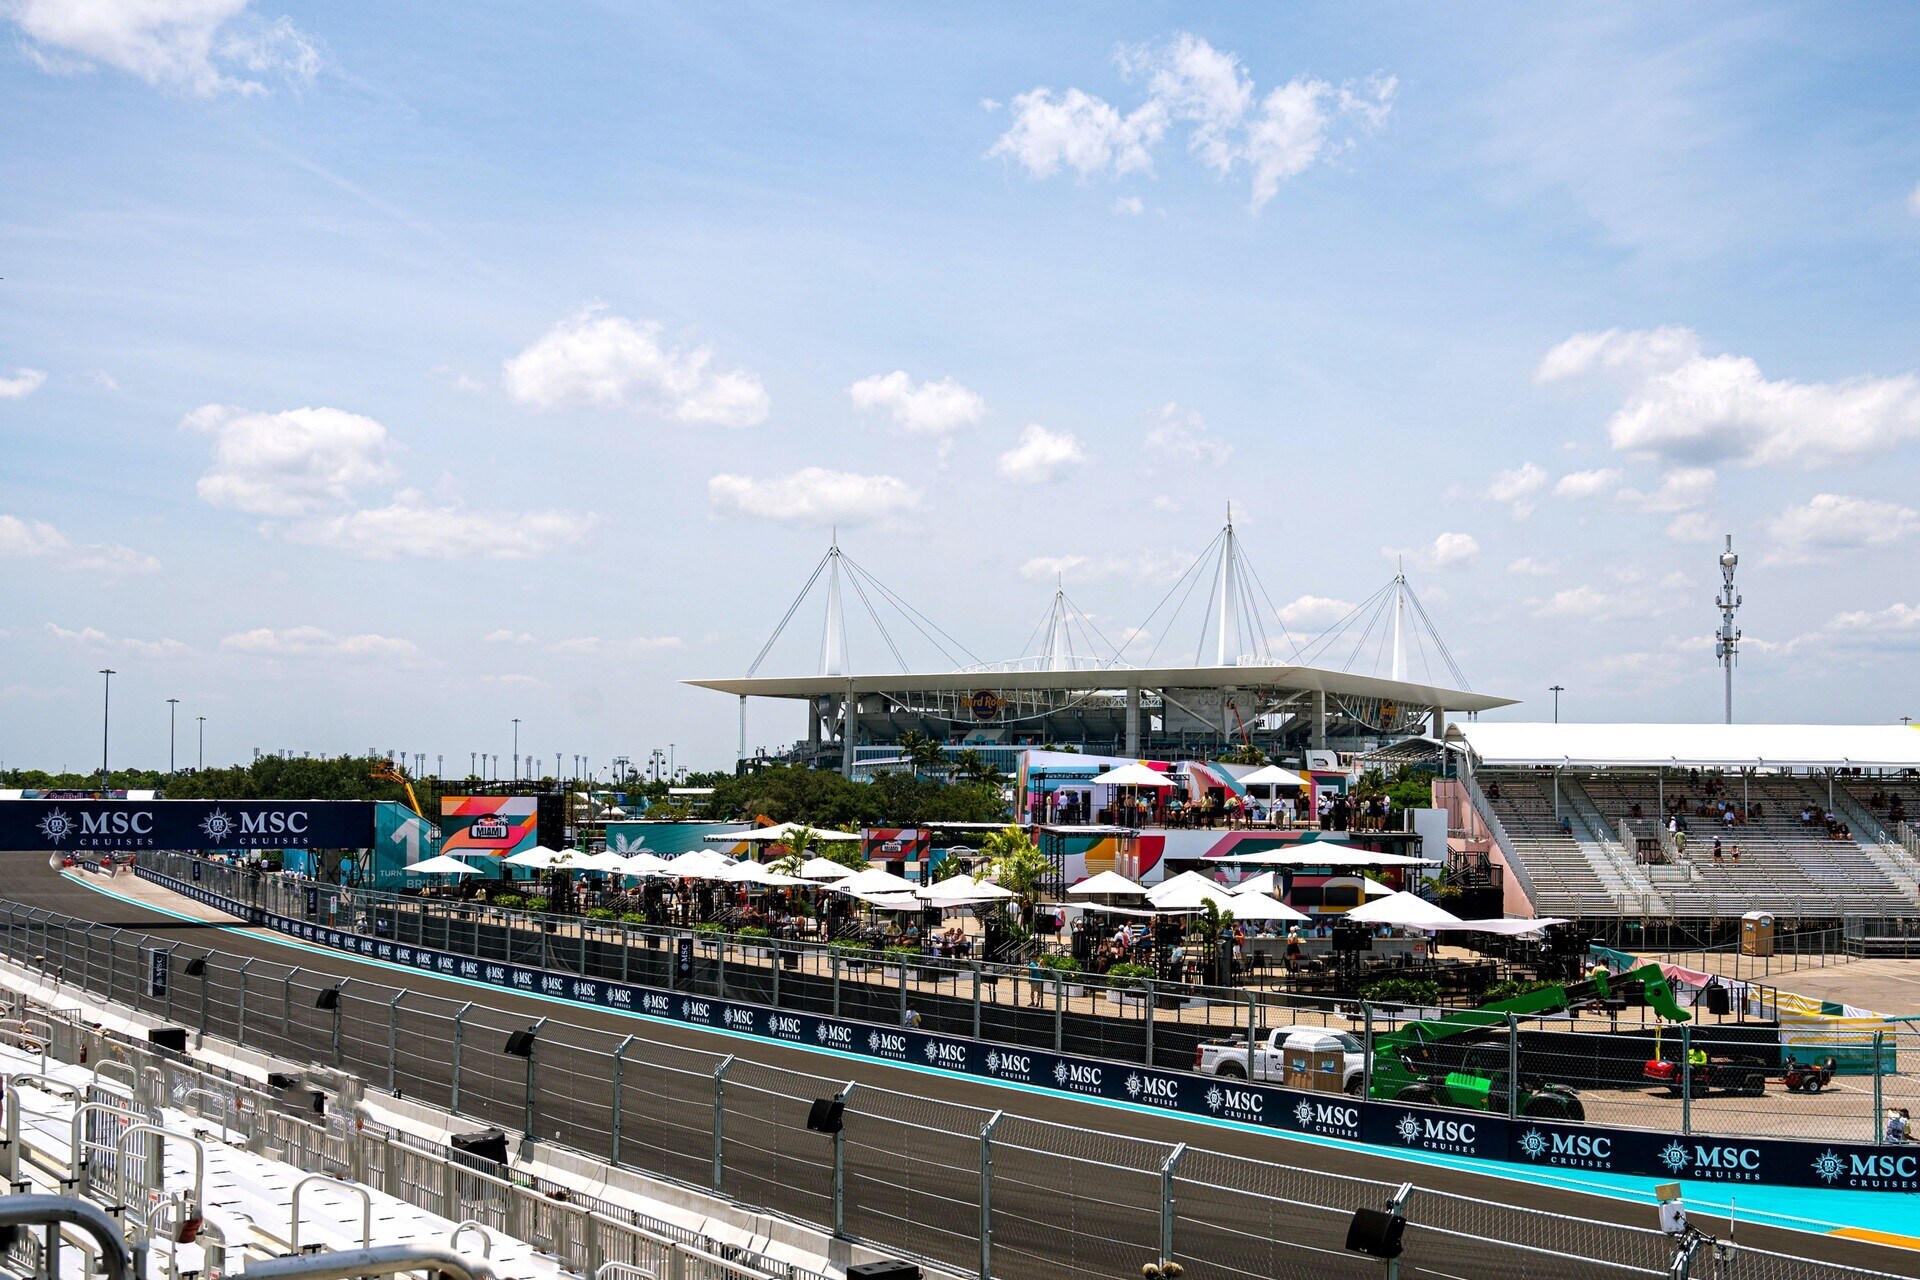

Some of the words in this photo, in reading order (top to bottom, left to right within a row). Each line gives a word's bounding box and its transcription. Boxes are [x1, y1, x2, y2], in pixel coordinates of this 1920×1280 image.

[80, 812, 153, 834] MSC
[239, 811, 308, 833] MSC
[80, 838, 154, 846] CRUISES
[239, 837, 308, 845] CRUISES
[390, 818, 419, 876] 1
[442, 957, 454, 969] MSC
[466, 962, 478, 974] MSC
[491, 966, 505, 979] MSC
[518, 971, 533, 984] MSC
[548, 977, 563, 990] MSC
[580, 982, 596, 996] MSC
[614, 988, 632, 1002] MSC
[651, 995, 669, 1009] MSC
[691, 1002, 710, 1017] MSC
[733, 1009, 754, 1024] MSC
[779, 1017, 801, 1033] MSC
[778, 1031, 801, 1041] CRUISES
[828, 1025, 852, 1042] MSC
[828, 1040, 852, 1050] CRUISES
[881, 1034, 906, 1051] MSC
[881, 1050, 906, 1060] CRUISES
[938, 1043, 966, 1061] MSC
[938, 1060, 966, 1070] CRUISES
[1001, 1053, 1031, 1072] MSC
[1001, 1071, 1031, 1081] CRUISES
[1070, 1065, 1101, 1085] MSC
[1070, 1082, 1102, 1094] CRUISES
[1143, 1076, 1178, 1098] MSC
[1142, 1095, 1178, 1108] CRUISES
[1225, 1090, 1263, 1112] MSC
[1224, 1109, 1263, 1122] CRUISES
[1316, 1104, 1358, 1127] MSC
[1315, 1123, 1358, 1138] CRUISES
[1424, 1118, 1475, 1143] MSC
[1424, 1140, 1475, 1154] CRUISES
[1551, 1133, 1611, 1158] MSC
[1551, 1156, 1611, 1169] CRUISES
[1695, 1146, 1760, 1169] MSC
[1850, 1155, 1917, 1177] MSC
[1694, 1170, 1760, 1181] CRUISES
[1850, 1179, 1917, 1188] CRUISES
